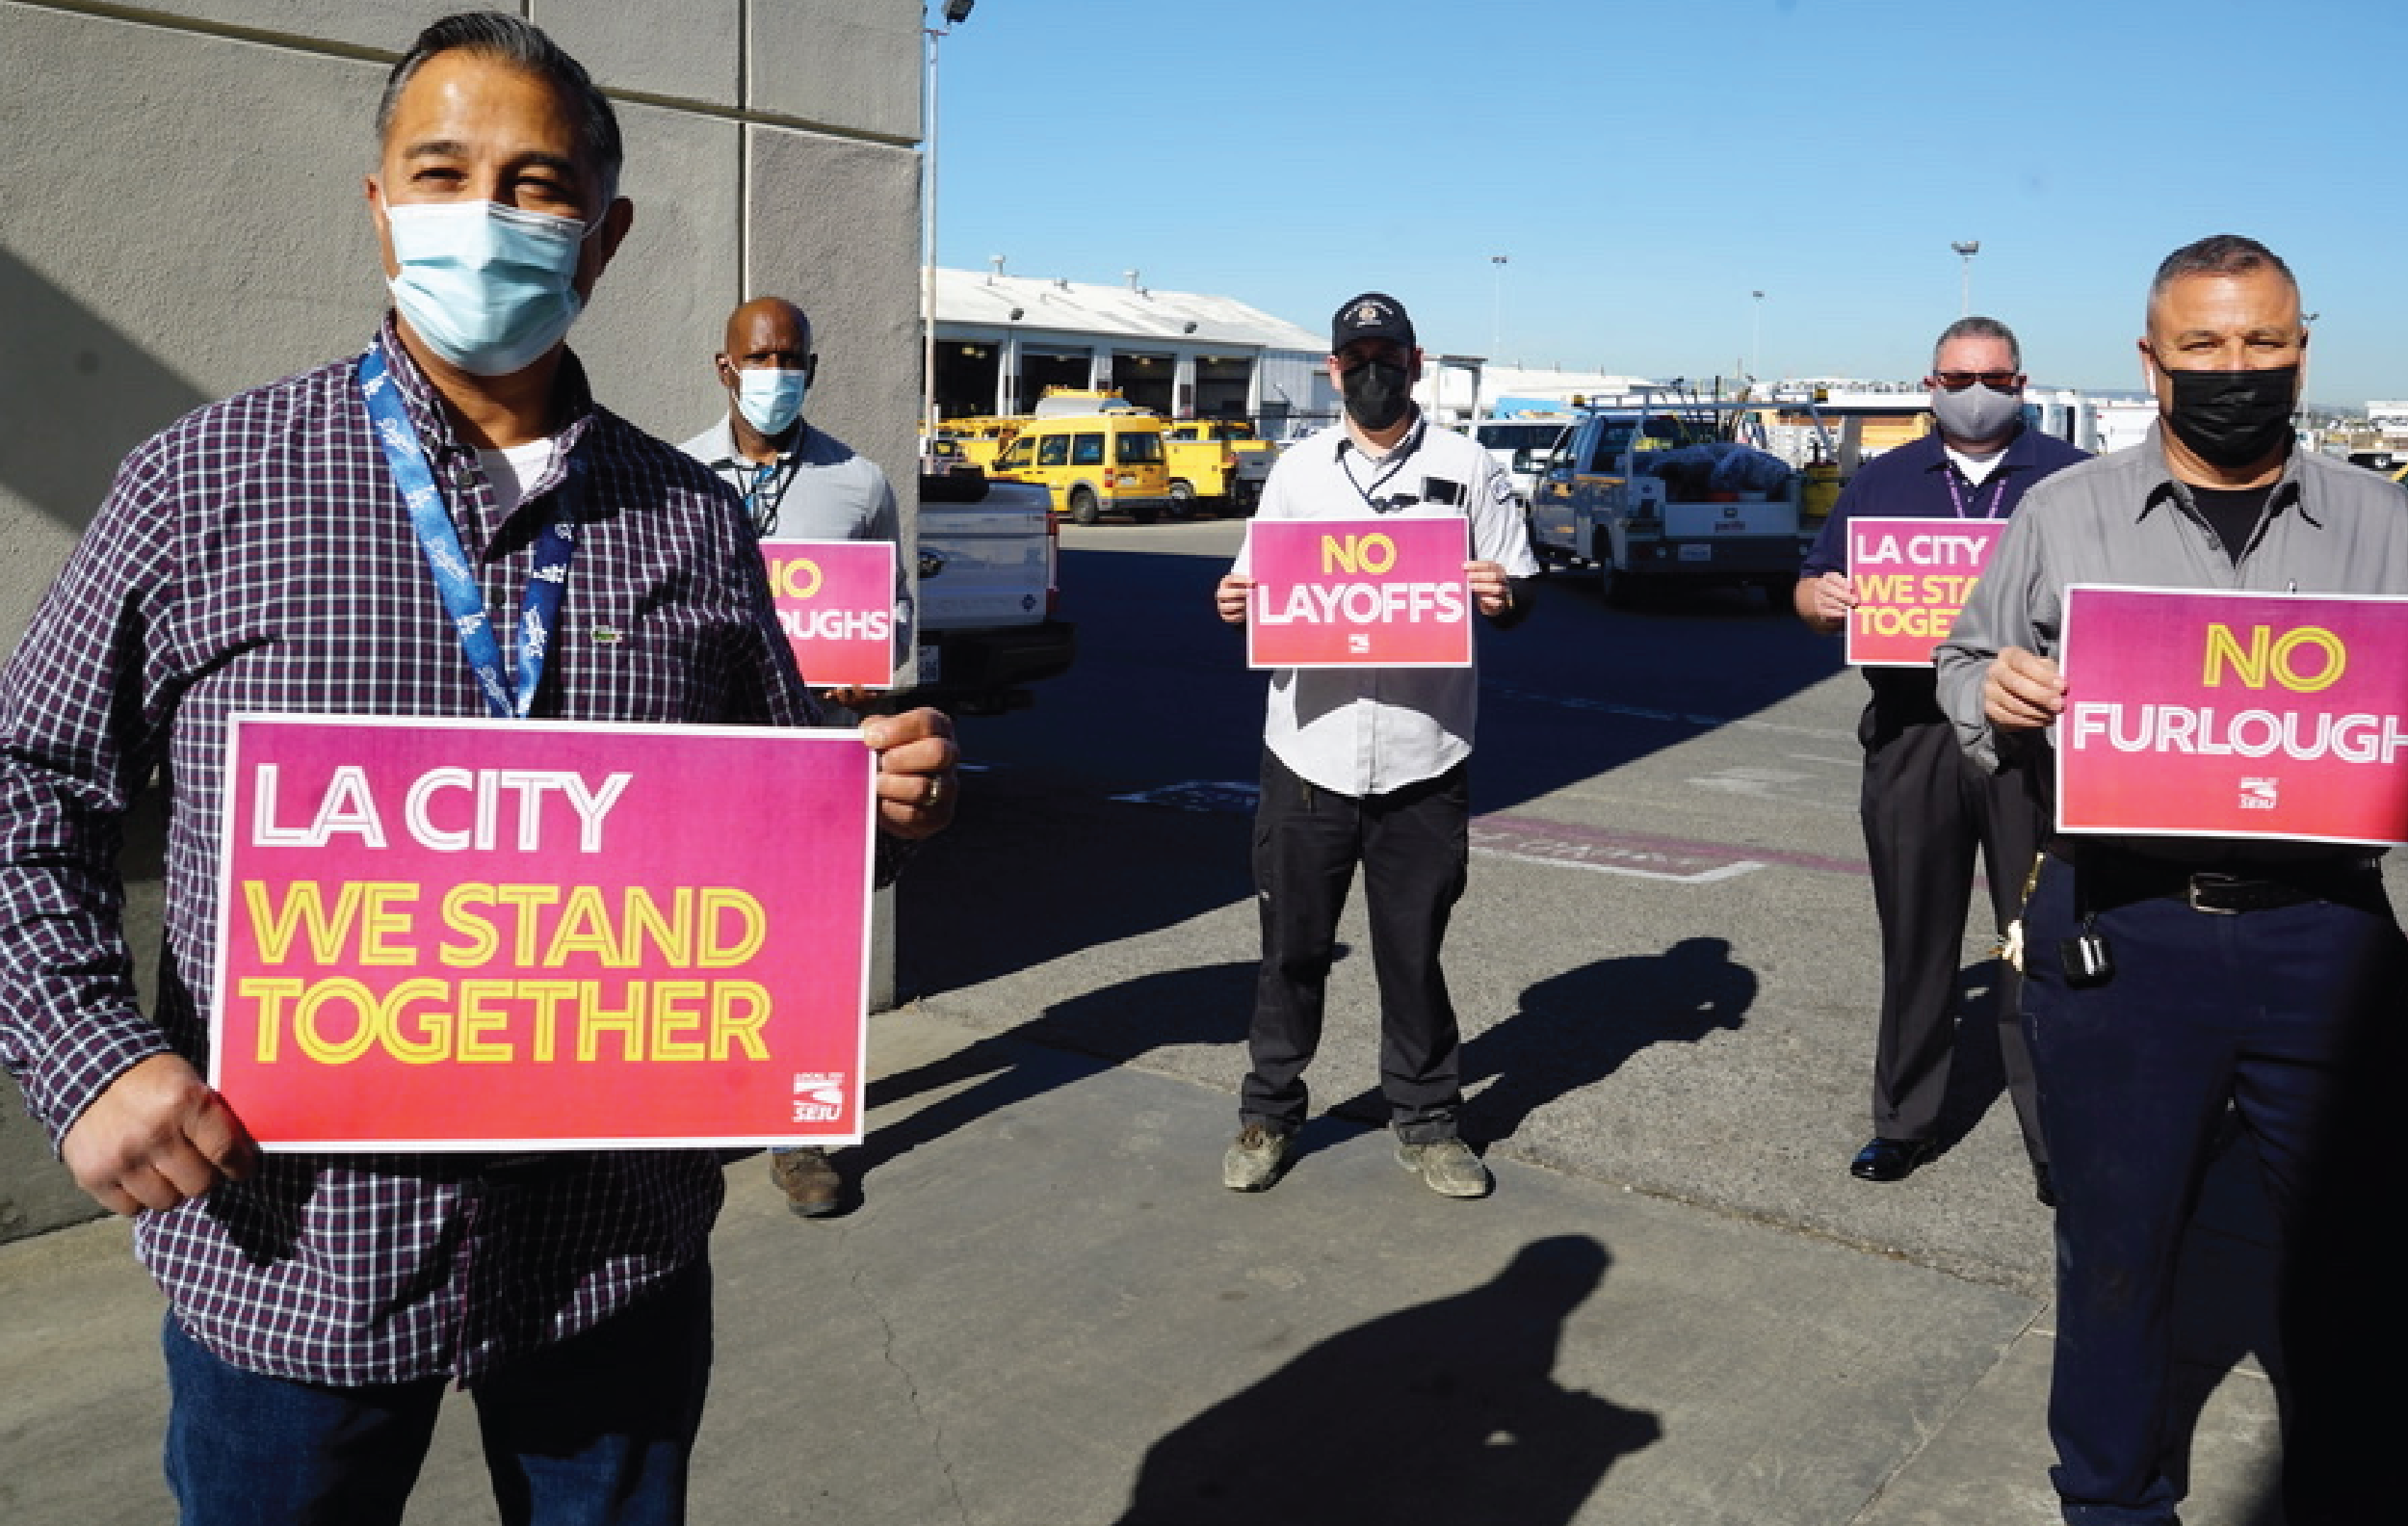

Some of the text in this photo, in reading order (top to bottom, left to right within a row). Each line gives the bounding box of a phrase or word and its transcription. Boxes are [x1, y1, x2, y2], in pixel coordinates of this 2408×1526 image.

[1321, 533, 1397, 576] NO
[1855, 533, 1989, 566] LA CITY
[1258, 582, 1465, 625] LAYOFFS
[1854, 573, 1915, 604] WE
[1854, 605, 1962, 637] TOGE
[2202, 622, 2347, 694] NO
[251, 763, 633, 853] LA CITY
[243, 880, 767, 969] WE STAND
[239, 976, 772, 1066] TOGETHER
